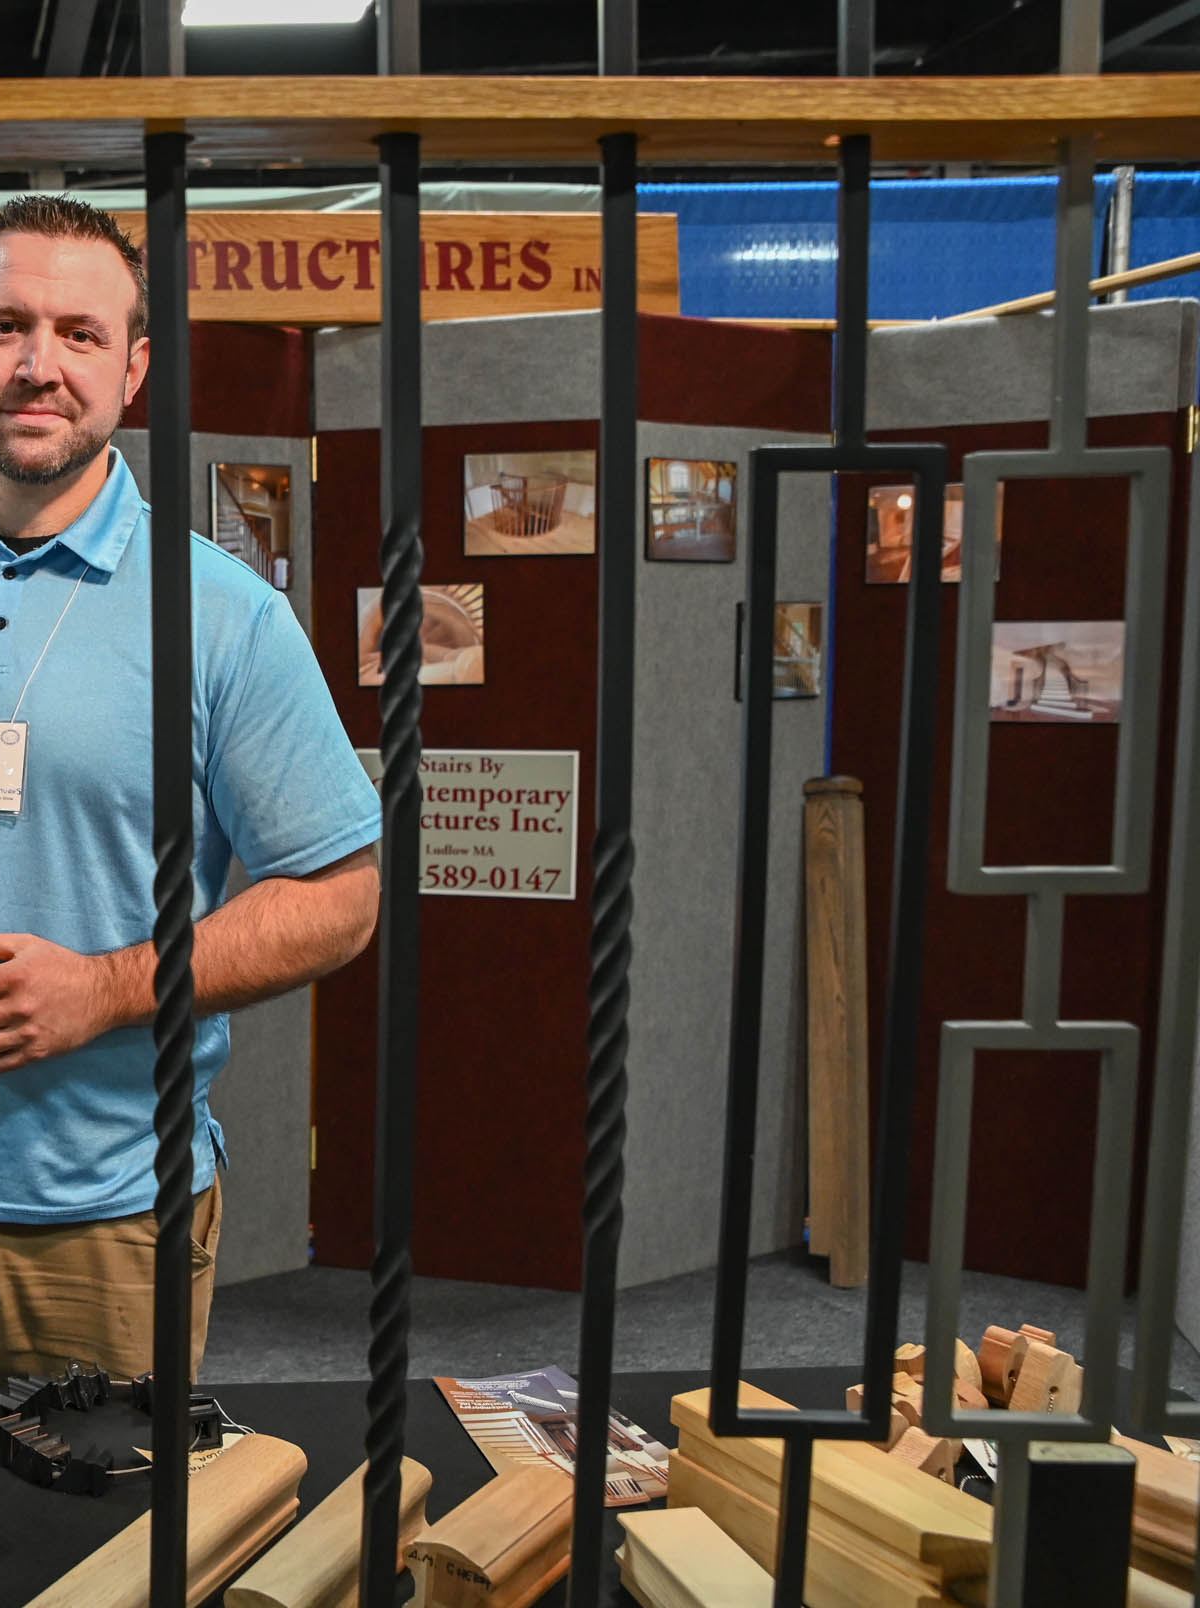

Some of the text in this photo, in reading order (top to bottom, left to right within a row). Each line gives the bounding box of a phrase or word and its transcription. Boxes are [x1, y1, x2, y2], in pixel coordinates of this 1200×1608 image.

[186, 239, 552, 292] TRUCTRES
[573, 267, 602, 293] IN
[419, 757, 504, 780] Stairs By
[422, 784, 571, 813] temporary
[420, 808, 563, 833] ctures Inc.
[426, 844, 495, 857] Ludlow MA
[419, 864, 562, 893] -589-0147
